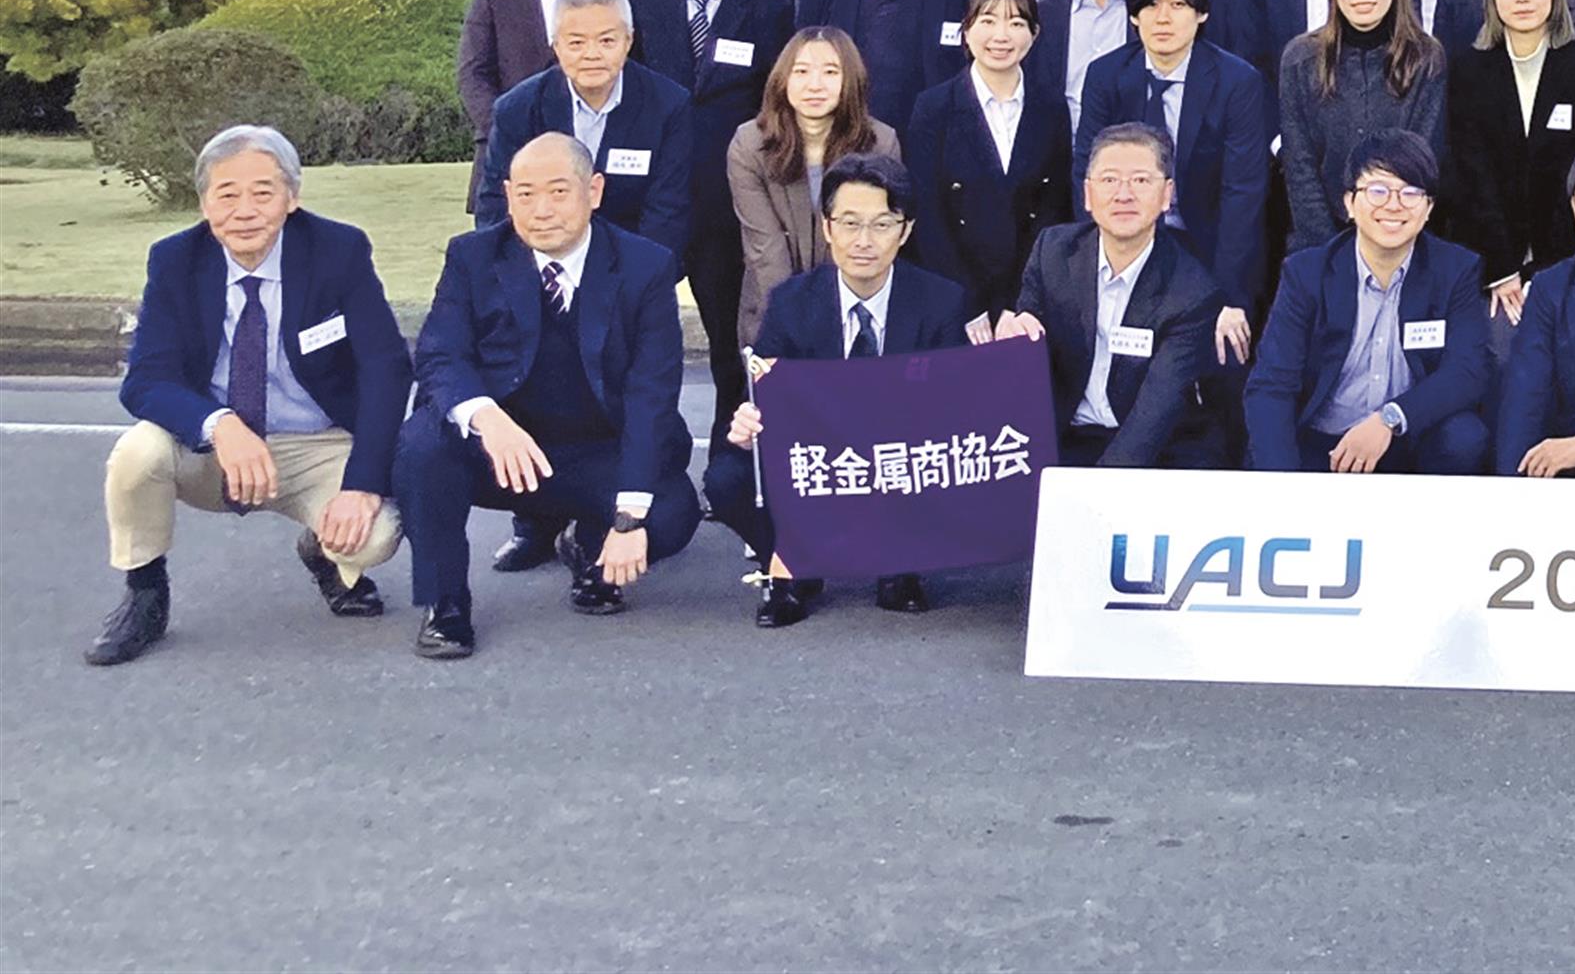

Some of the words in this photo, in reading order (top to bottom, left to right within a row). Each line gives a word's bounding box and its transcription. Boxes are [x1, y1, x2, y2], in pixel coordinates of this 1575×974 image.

[789, 424, 1032, 497] 軽金属商協会
[1104, 533, 1363, 614] UACJ
